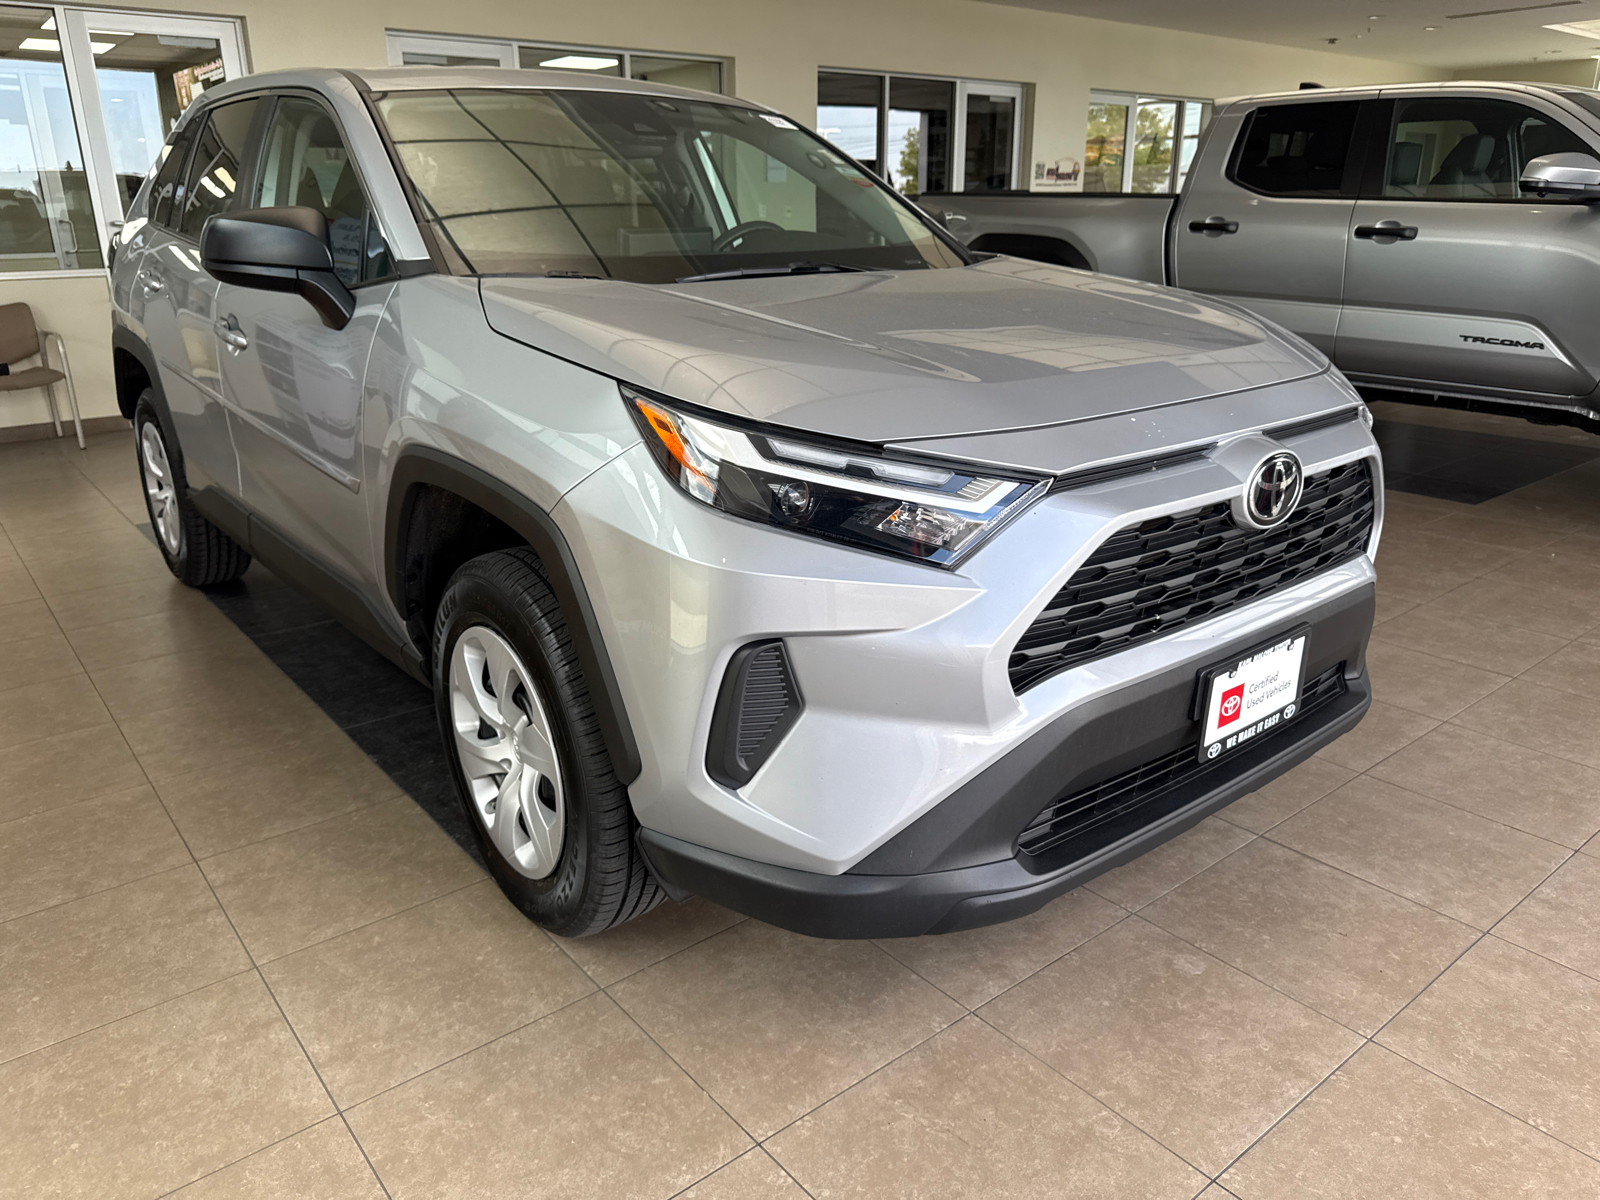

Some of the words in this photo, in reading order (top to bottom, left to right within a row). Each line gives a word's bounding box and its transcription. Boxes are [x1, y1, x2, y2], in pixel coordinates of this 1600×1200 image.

[1459, 334, 1545, 350] TACOMA
[1246, 691, 1266, 710] Used
[1265, 679, 1292, 700] Vehicles
[1249, 670, 1280, 694] Certified
[1226, 735, 1238, 749] WE
[1237, 725, 1257, 743] MAKE
[1256, 721, 1265, 734] IT
[1264, 712, 1281, 730] EASY
